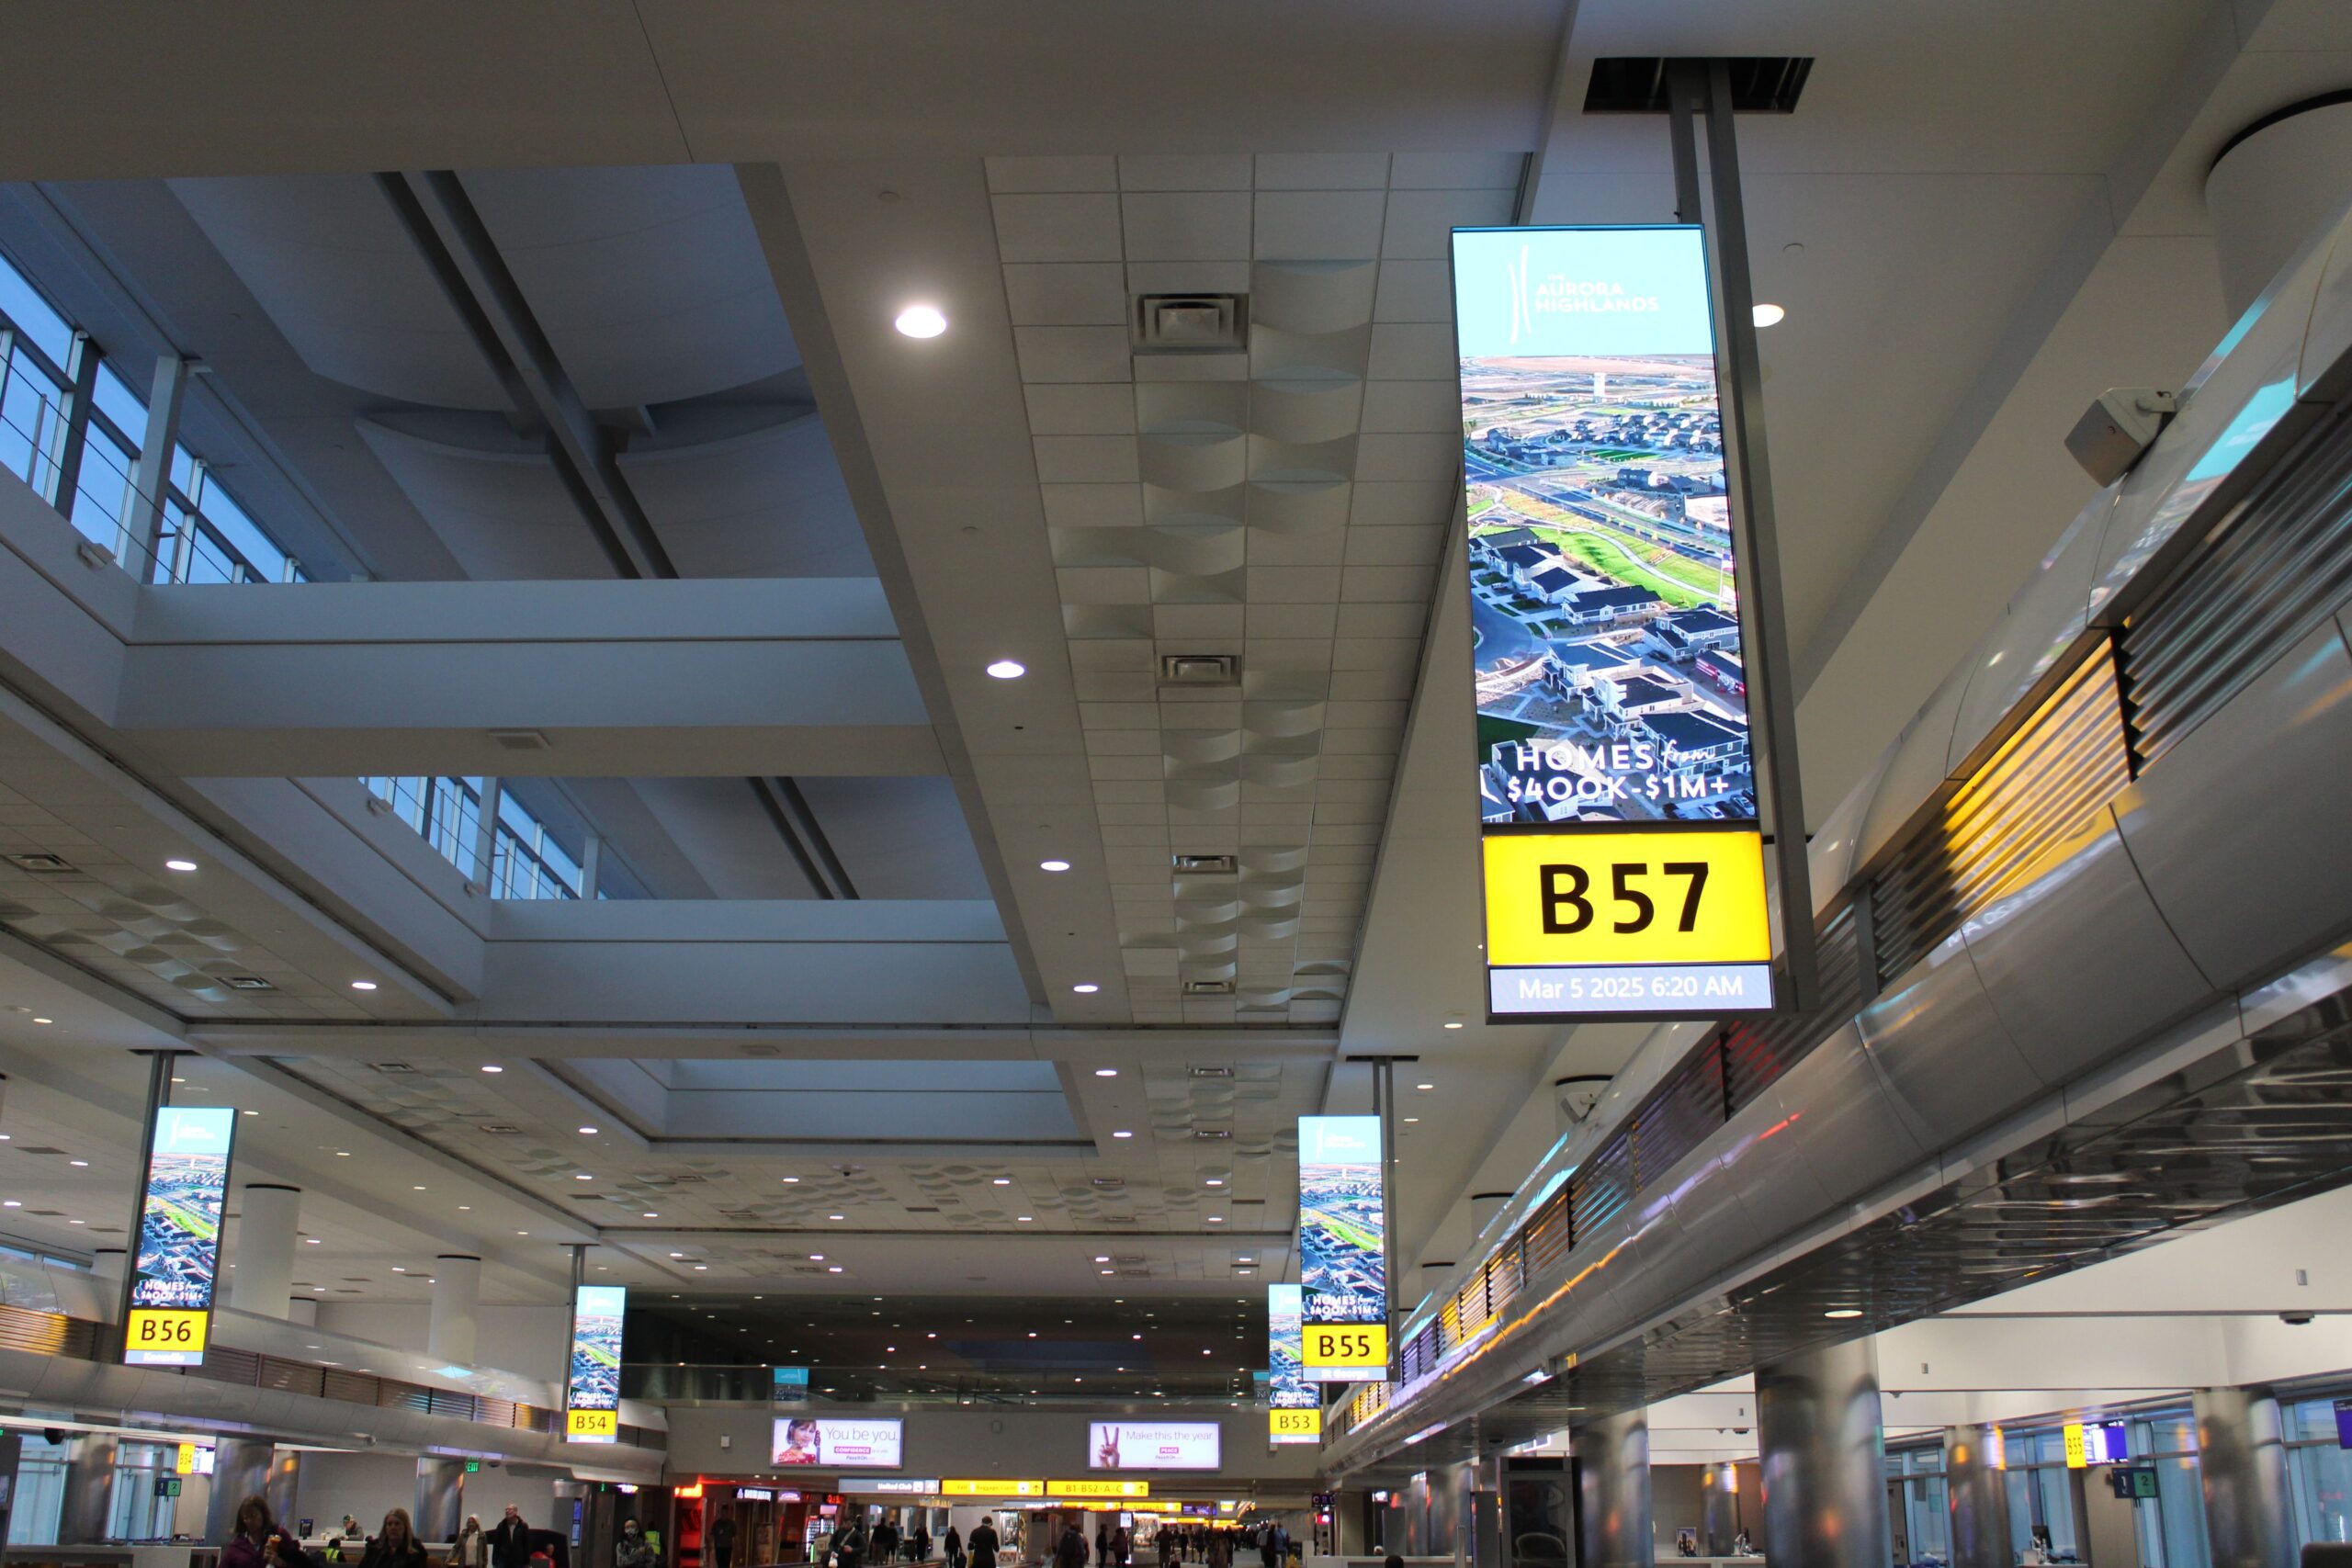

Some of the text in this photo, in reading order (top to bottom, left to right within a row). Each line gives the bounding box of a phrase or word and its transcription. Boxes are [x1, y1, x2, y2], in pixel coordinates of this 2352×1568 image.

[1536, 281, 1624, 295] AURORA
[1534, 296, 1661, 312] HIGHLANDS
[1517, 739, 1715, 772] HOMES from
[1540, 862, 1709, 934] B57
[1519, 976, 1743, 999] Mar 5 2025 6:20 AM
[144, 1280, 184, 1291] HOMES
[1313, 1295, 1356, 1305] HOMES
[141, 1320, 191, 1342] B56
[1319, 1335, 1371, 1358] B55
[576, 1416, 606, 1429] B54
[1280, 1416, 1310, 1429] B53
[826, 1427, 899, 1443] You be you.
[1126, 1430, 1153, 1440] Make
[1155, 1430, 1172, 1440] this
[1174, 1430, 1190, 1440] the
[2067, 1437, 2082, 1455] B55
[467, 1462, 479, 1472] EXIT
[2141, 1475, 2149, 1486] 2
